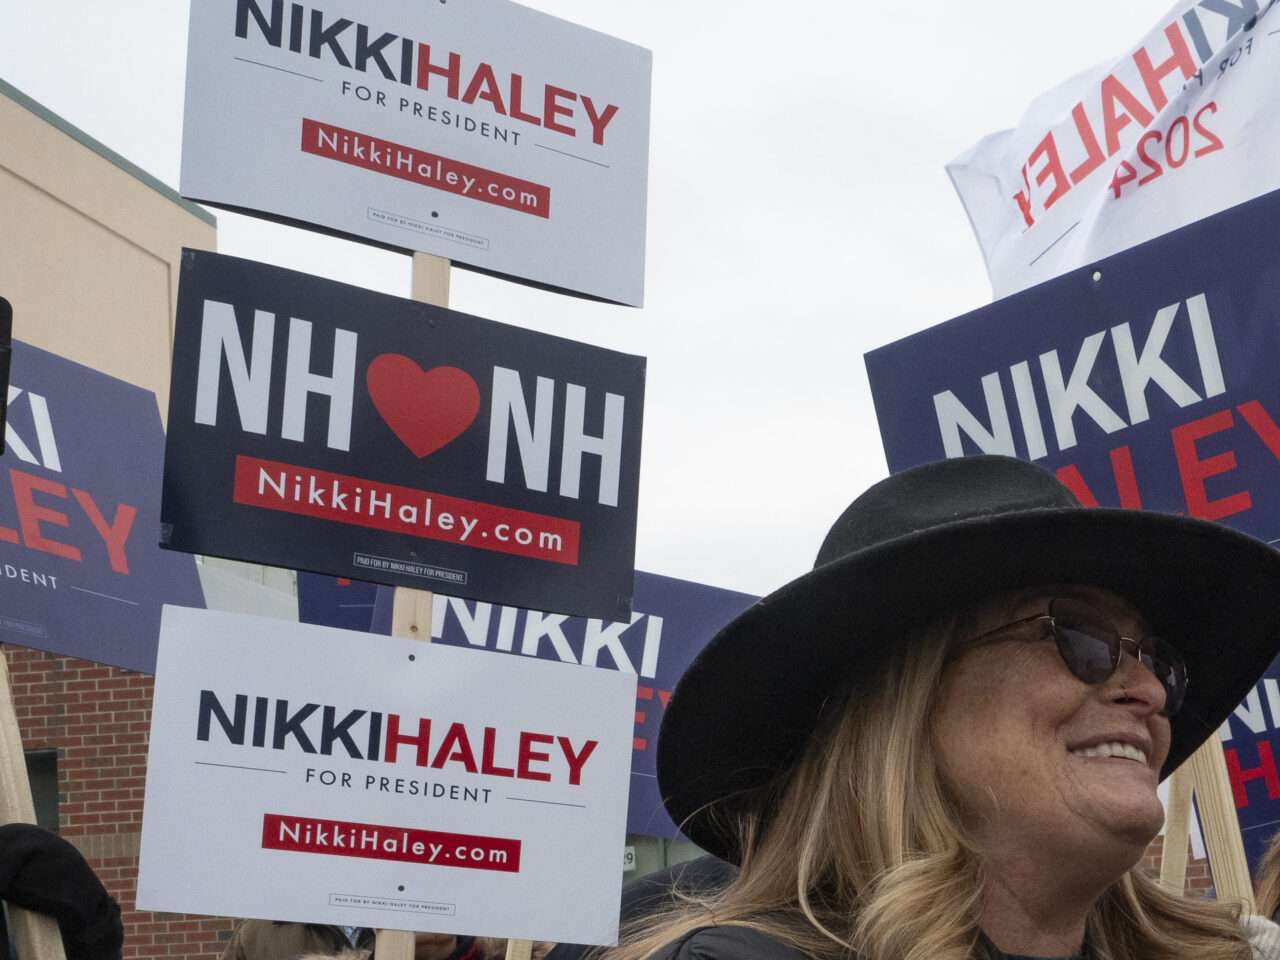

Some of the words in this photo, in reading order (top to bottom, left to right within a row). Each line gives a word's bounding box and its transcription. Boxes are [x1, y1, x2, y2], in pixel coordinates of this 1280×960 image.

[341, 81, 387, 108] FOR
[399, 97, 522, 147] PRESIDENT
[317, 128, 539, 208] NikkiHaley.com
[194, 299, 359, 452] NH
[486, 365, 626, 508] NH
[932, 292, 1227, 462] NIKKI
[257, 467, 564, 553] NikkiHaley.com
[431, 592, 664, 680] NIKKI
[306, 768, 352, 789] FOR
[365, 775, 493, 804] PRESIDENT
[278, 821, 508, 865] NikkiHaley.com
